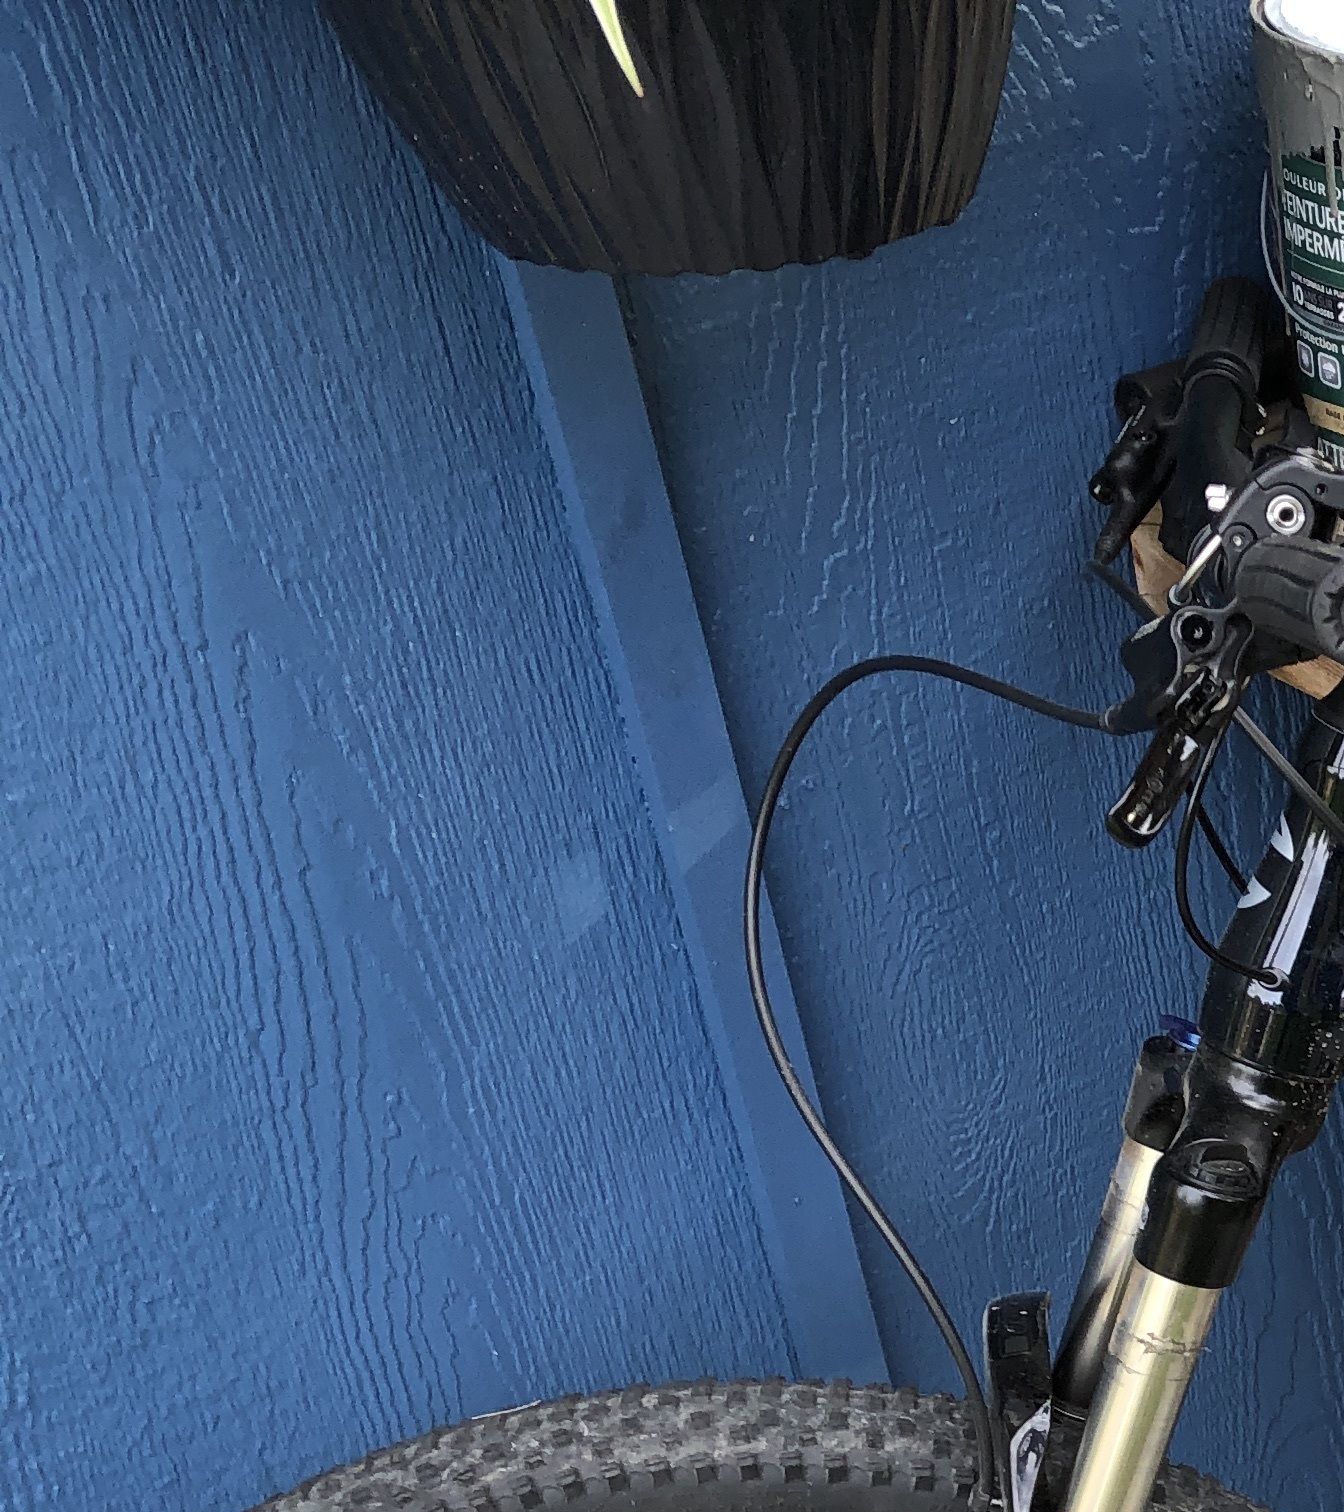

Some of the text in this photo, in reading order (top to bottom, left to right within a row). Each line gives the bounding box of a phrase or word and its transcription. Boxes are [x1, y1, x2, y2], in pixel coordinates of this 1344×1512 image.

[1282, 167, 1327, 197] OULEUR
[1292, 281, 1304, 305] 10
[1295, 322, 1339, 354] Protection
